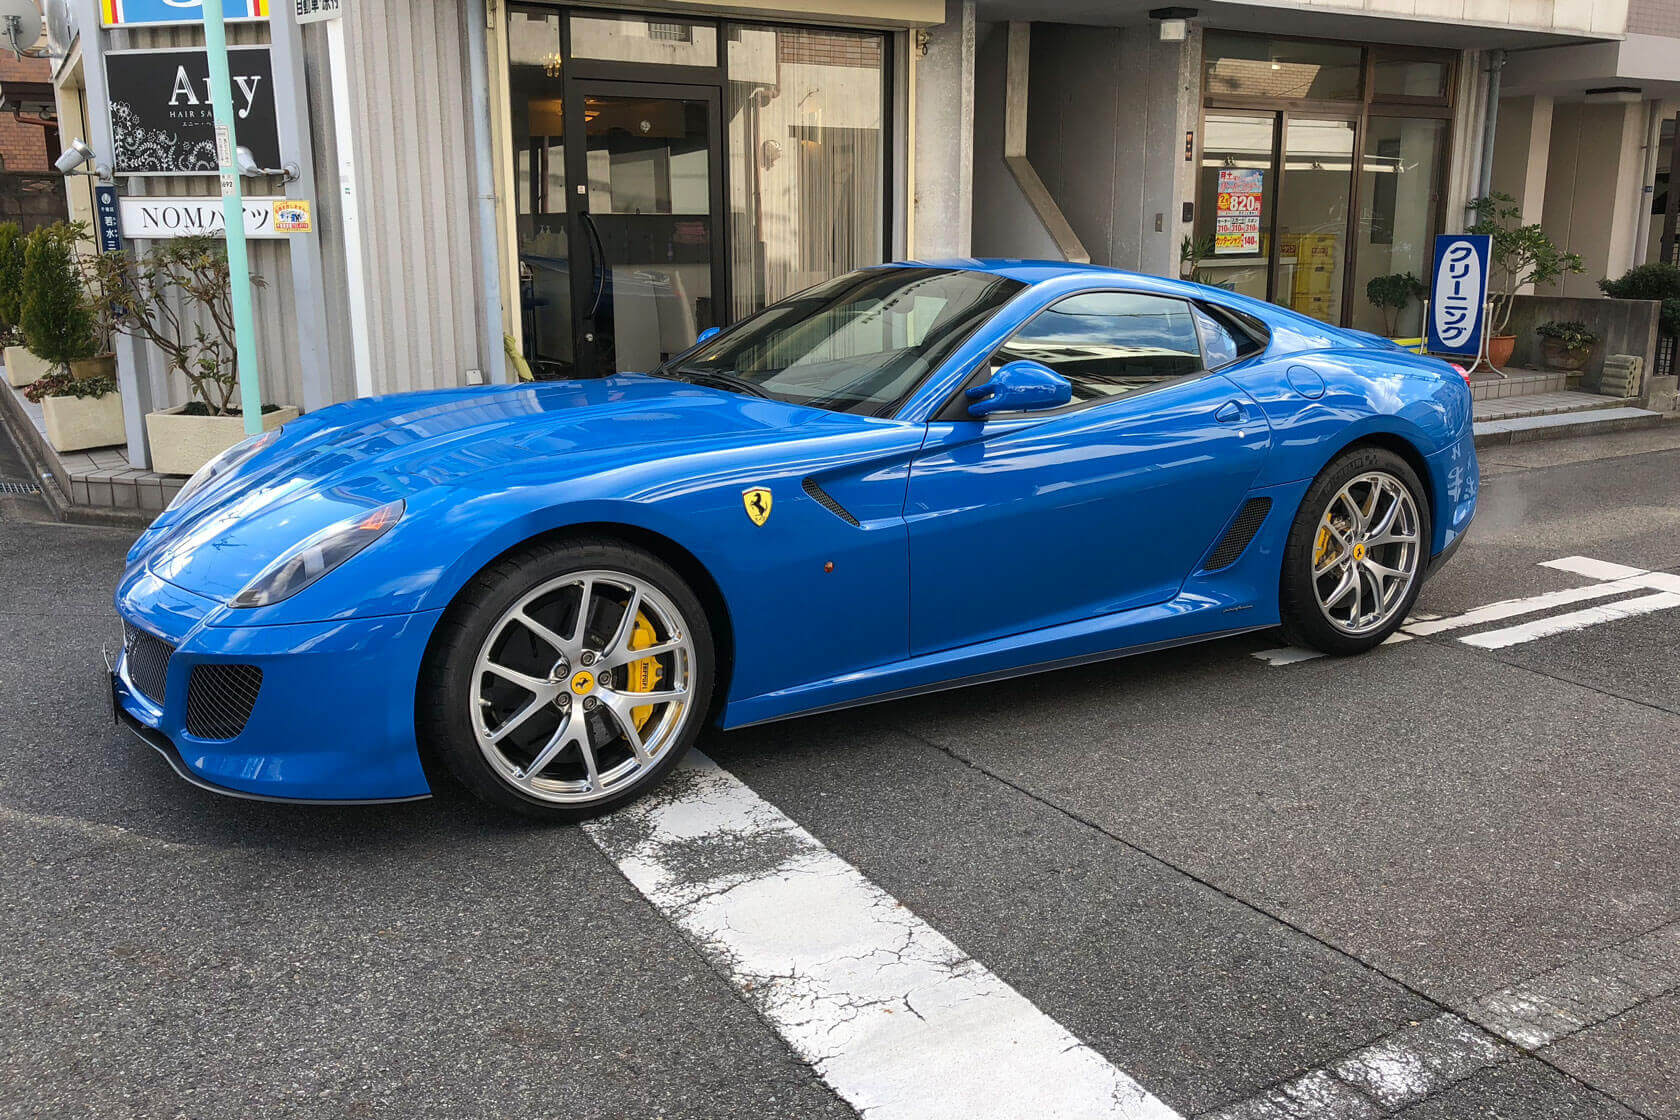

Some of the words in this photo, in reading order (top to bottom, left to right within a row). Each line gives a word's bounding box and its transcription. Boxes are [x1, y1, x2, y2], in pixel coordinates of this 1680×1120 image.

[140, 206, 269, 230] NOMハツ
[1442, 246, 1472, 341] クリーニング
